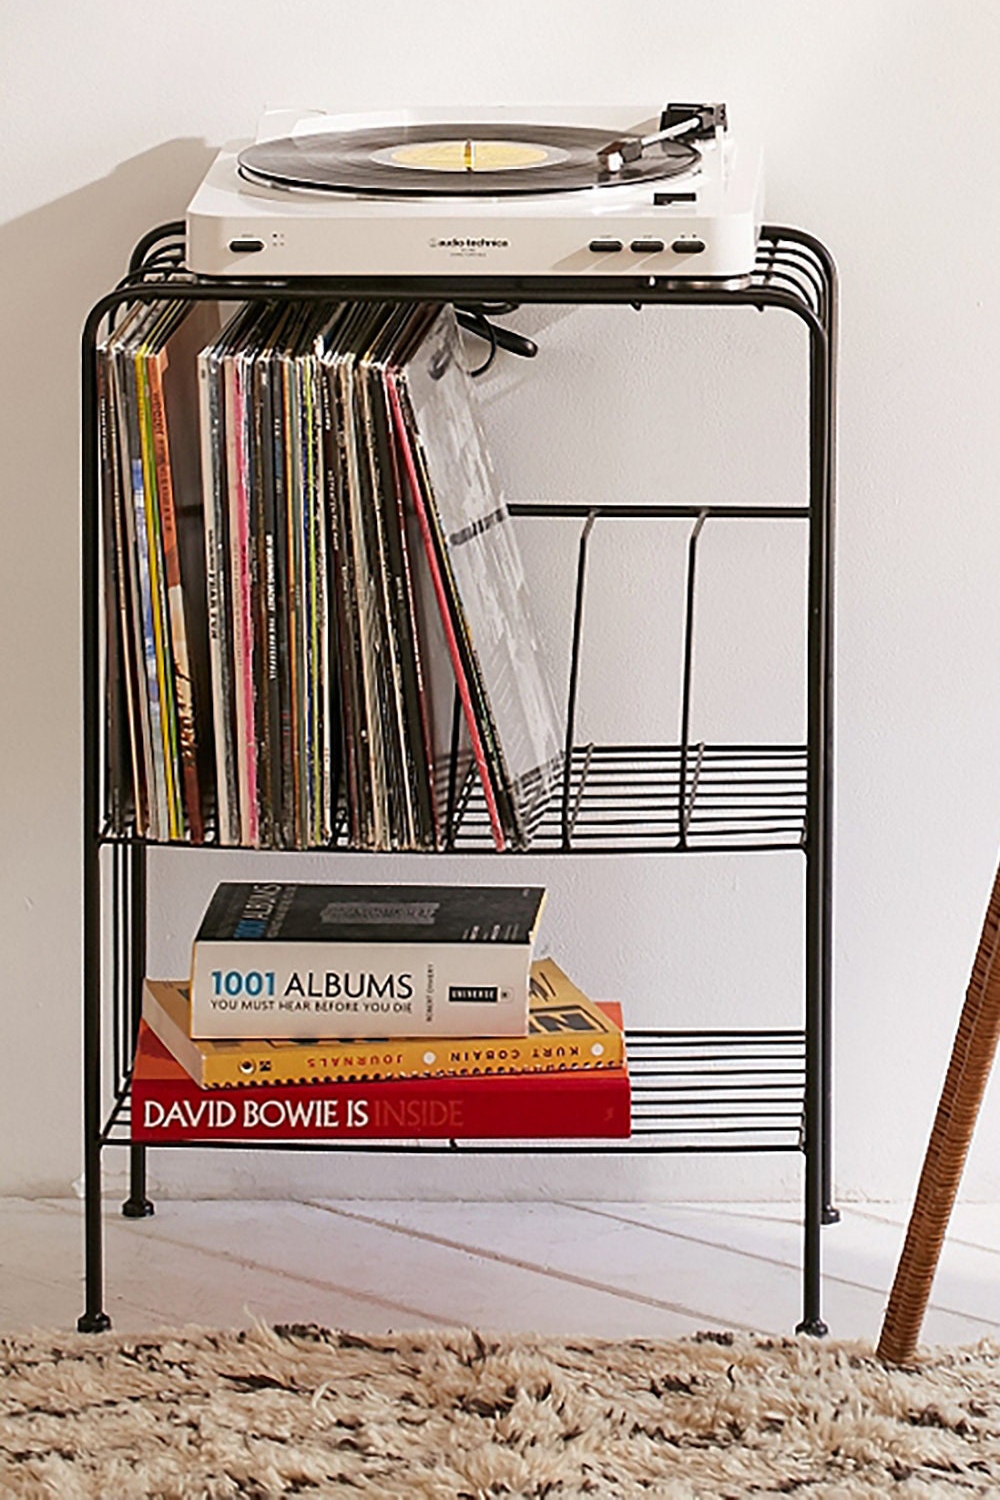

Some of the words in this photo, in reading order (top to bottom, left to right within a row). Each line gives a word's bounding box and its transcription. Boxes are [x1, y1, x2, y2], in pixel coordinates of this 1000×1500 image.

[211, 971, 275, 997] 1001
[284, 972, 413, 999] ALBUMS
[211, 1000, 237, 1011] YOU
[241, 1001, 275, 1011] MUST
[279, 1001, 310, 1012] HEAR
[315, 1002, 358, 1013] BEFORE
[364, 1002, 389, 1013] YOU
[393, 1002, 413, 1014] DIE
[450, 1048, 520, 1063] COBAIN
[531, 1045, 580, 1059] KURT
[307, 1053, 403, 1069] JOURNALS
[143, 1100, 237, 1128] DAVID
[243, 1100, 339, 1128] BOWIE
[347, 1100, 369, 1128] IS
[374, 1100, 464, 1128] INSIDE
